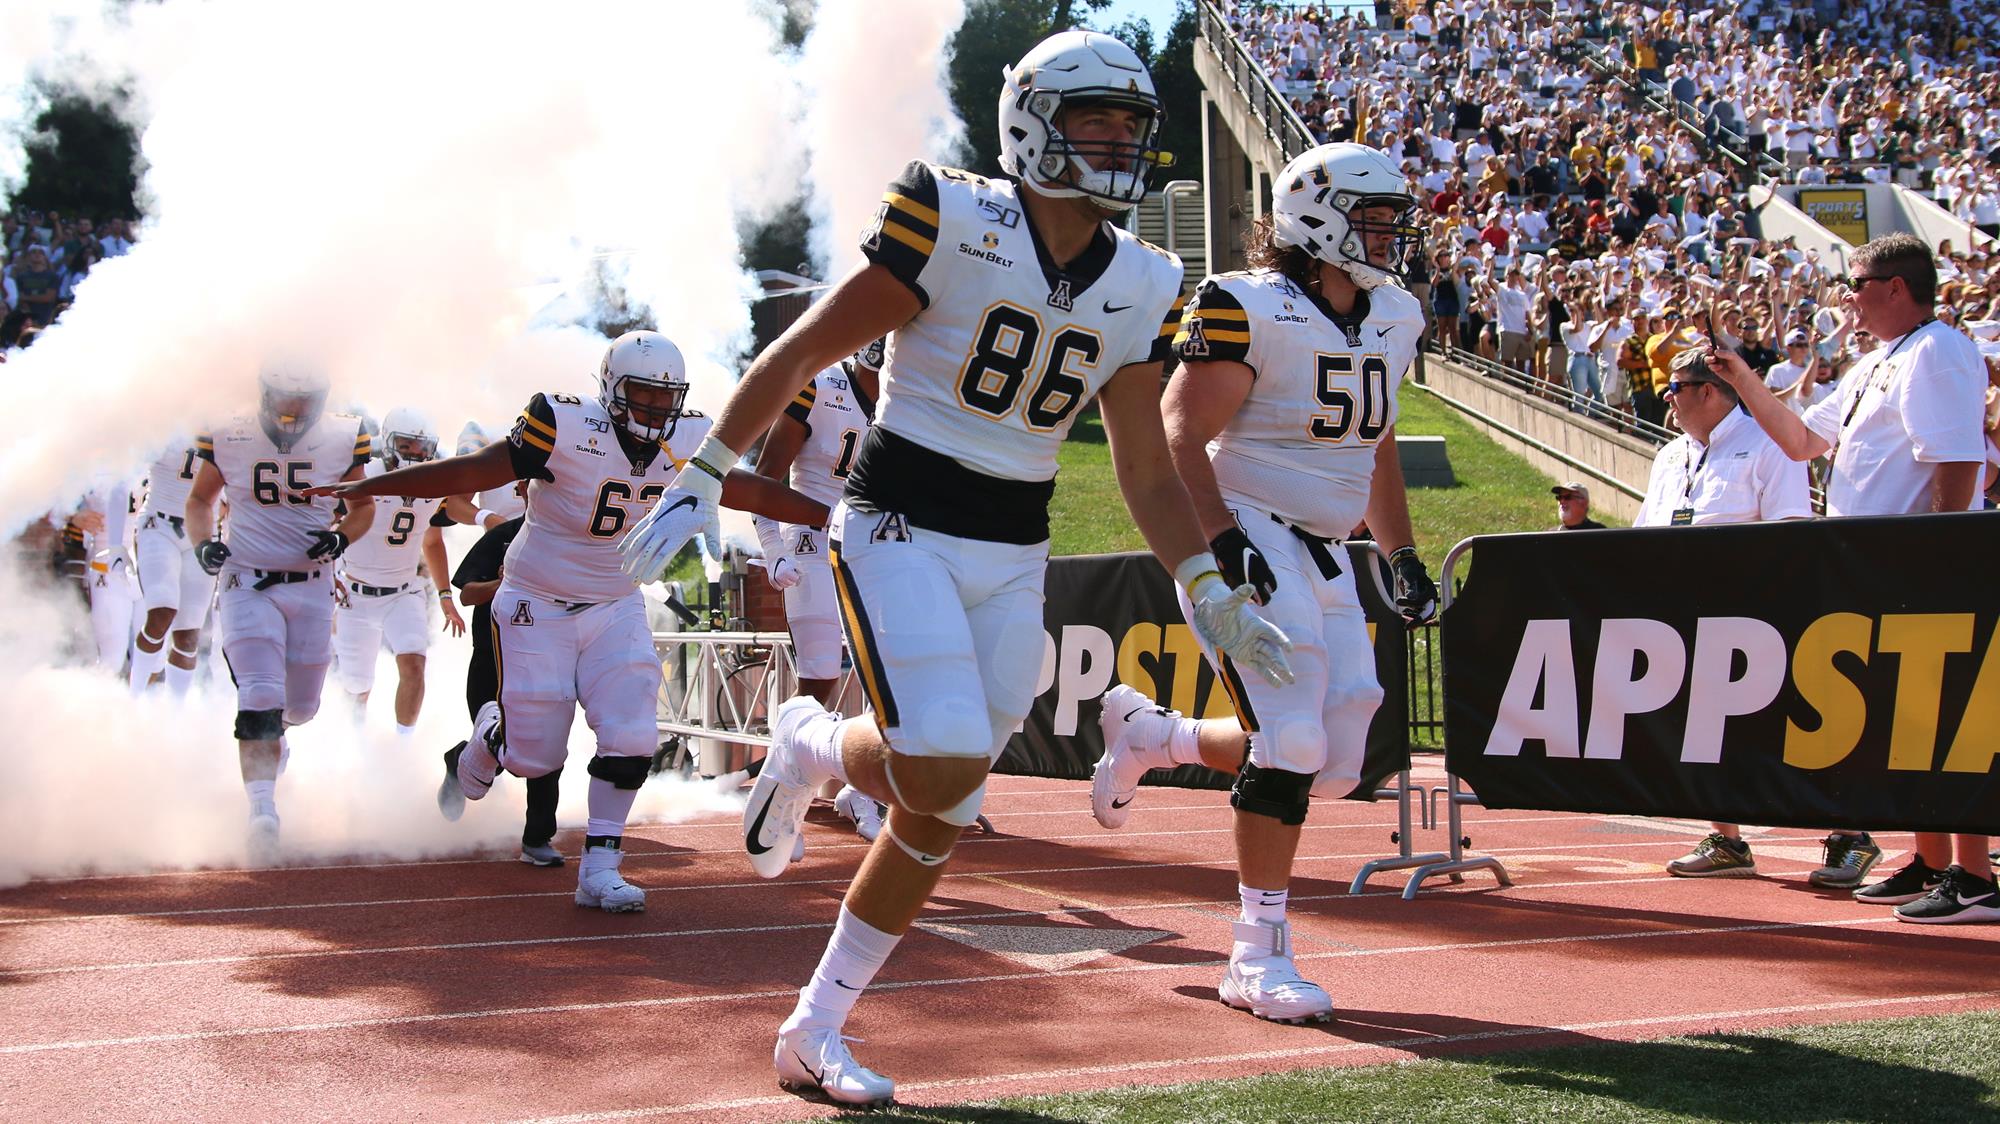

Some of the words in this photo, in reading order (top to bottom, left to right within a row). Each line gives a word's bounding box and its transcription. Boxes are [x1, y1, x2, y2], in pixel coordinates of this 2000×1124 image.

[977, 198, 1021, 229] 150
[1807, 202, 1864, 219] SPORTS
[1047, 280, 1073, 312] A
[1183, 317, 1209, 357] A
[1346, 325, 1363, 348] A
[954, 299, 1104, 433] 86
[1306, 351, 1391, 444] 50
[584, 416, 609, 434] 150
[252, 459, 314, 508] 65
[630, 460, 645, 476] A
[385, 509, 417, 548] 9
[870, 511, 912, 544] A
[795, 532, 817, 555] A
[225, 573, 242, 592] A
[510, 599, 534, 627] A
